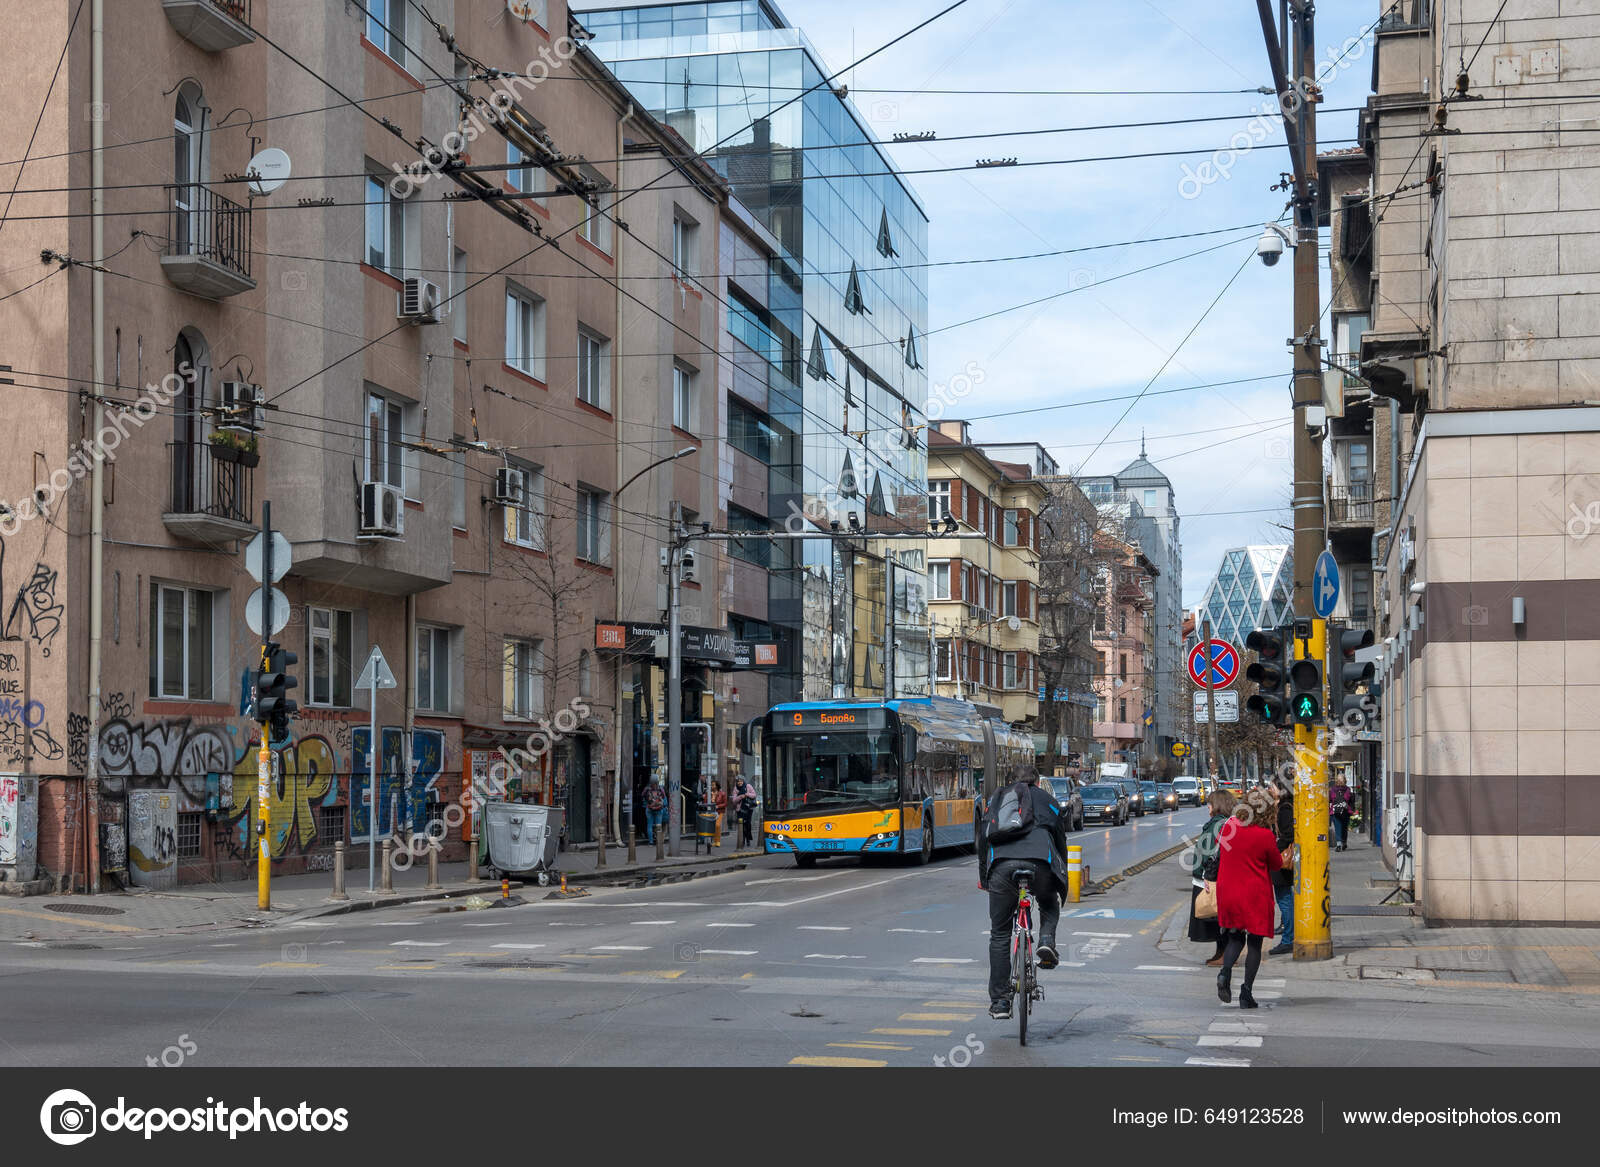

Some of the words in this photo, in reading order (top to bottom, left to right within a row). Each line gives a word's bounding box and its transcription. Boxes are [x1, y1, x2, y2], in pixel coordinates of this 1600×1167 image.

[602, 629, 621, 644] JBL
[760, 647, 774, 660] JBL
[793, 712, 803, 726] 9
[792, 824, 813, 832] 2818
